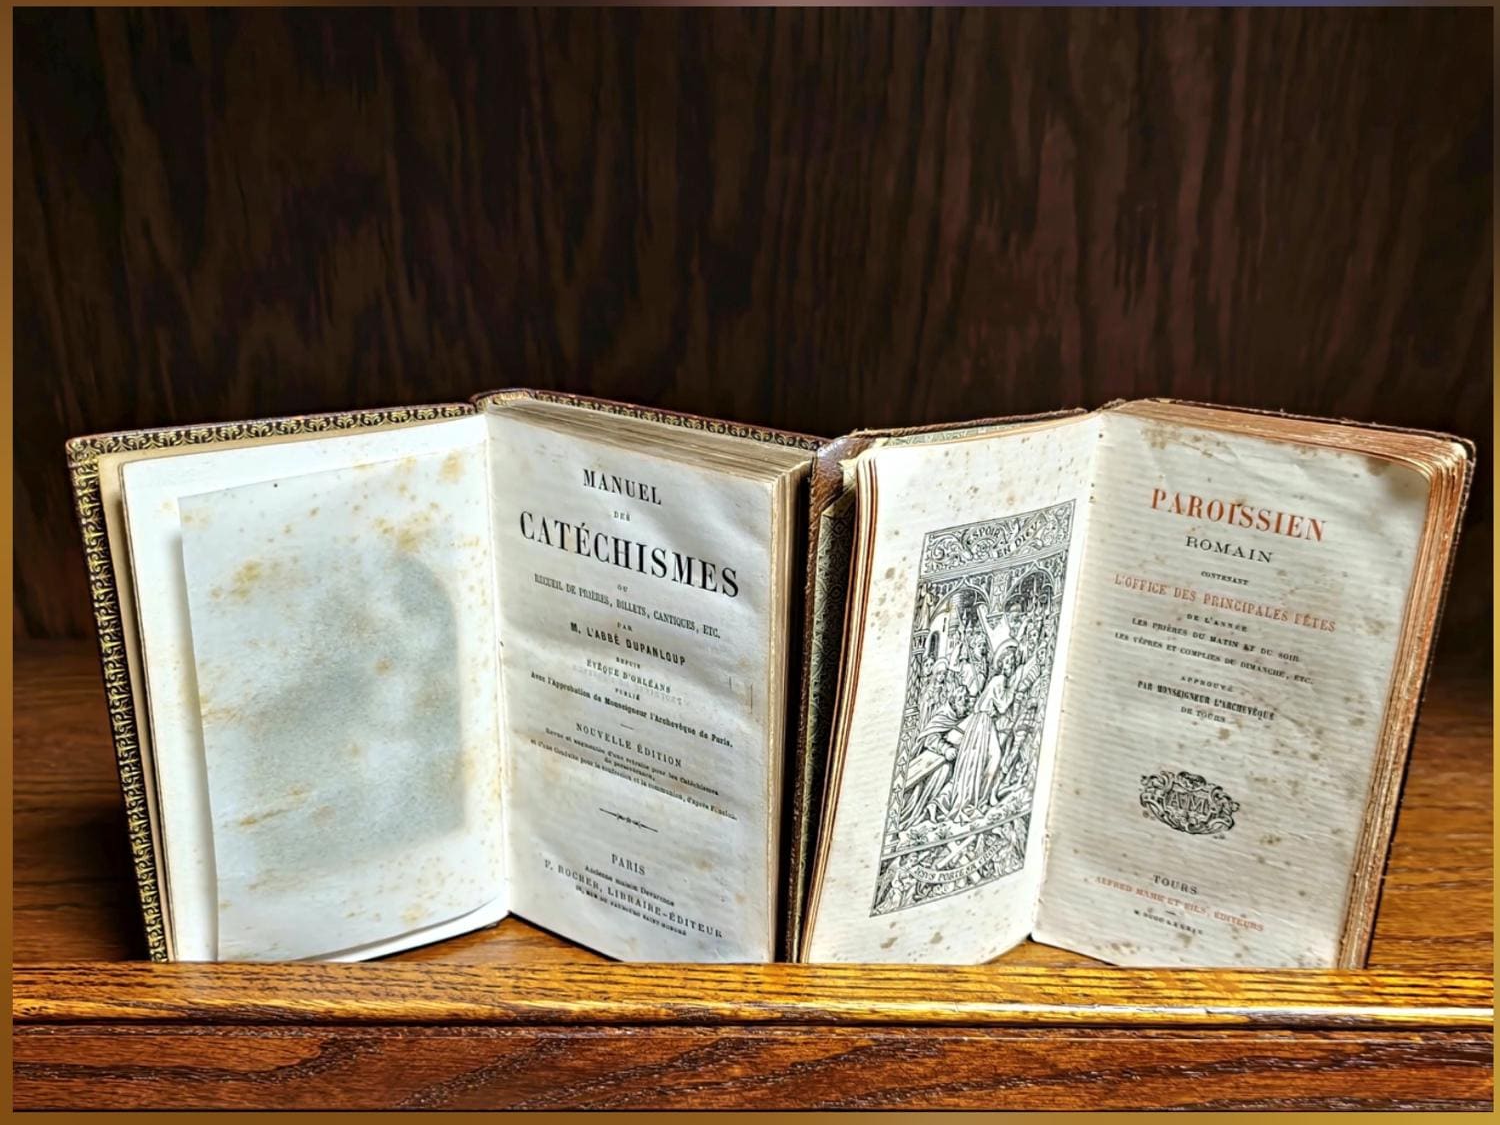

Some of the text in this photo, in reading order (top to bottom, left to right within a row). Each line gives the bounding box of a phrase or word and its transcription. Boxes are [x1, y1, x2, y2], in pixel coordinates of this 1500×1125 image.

[583, 469, 662, 505] MANUEL
[614, 511, 630, 522] DES
[1151, 488, 1329, 542] PAROISSIEN
[520, 511, 739, 597] CATÉCHISMES
[1186, 535, 1274, 563] ROMAIN
[534, 574, 563, 591] RECUEIL
[566, 583, 576, 595] DE
[616, 599, 650, 619] BILLETS,
[653, 611, 699, 634] CANTIQUES,
[703, 624, 720, 639] ETC.
[1115, 574, 1337, 633] L'OFFICE DES PRINCIPALES FÊTES
[571, 622, 686, 666] M. L'ABBÉ DUPANLOUP
[1115, 632, 1129, 641] LES
[1166, 644, 1177, 652] ET
[1132, 617, 1147, 627] LES
[1193, 631, 1205, 640] DU
[1210, 635, 1238, 648] MATIN
[623, 670, 671, 693] D'ORLÉANS
[1138, 680, 1153, 691] PAR
[1157, 684, 1209, 705] MONSEIGNEUR
[605, 696, 647, 719] Monseigneur
[712, 733, 733, 747] Paris.
[577, 723, 682, 767] NOUVELLE ÉDITION
[611, 853, 645, 875] PARIS
[558, 866, 602, 892] ROCHER,
[608, 887, 722, 938] LIBRAIRE-ÉDITEUR
[1153, 874, 1199, 895] TOURS
